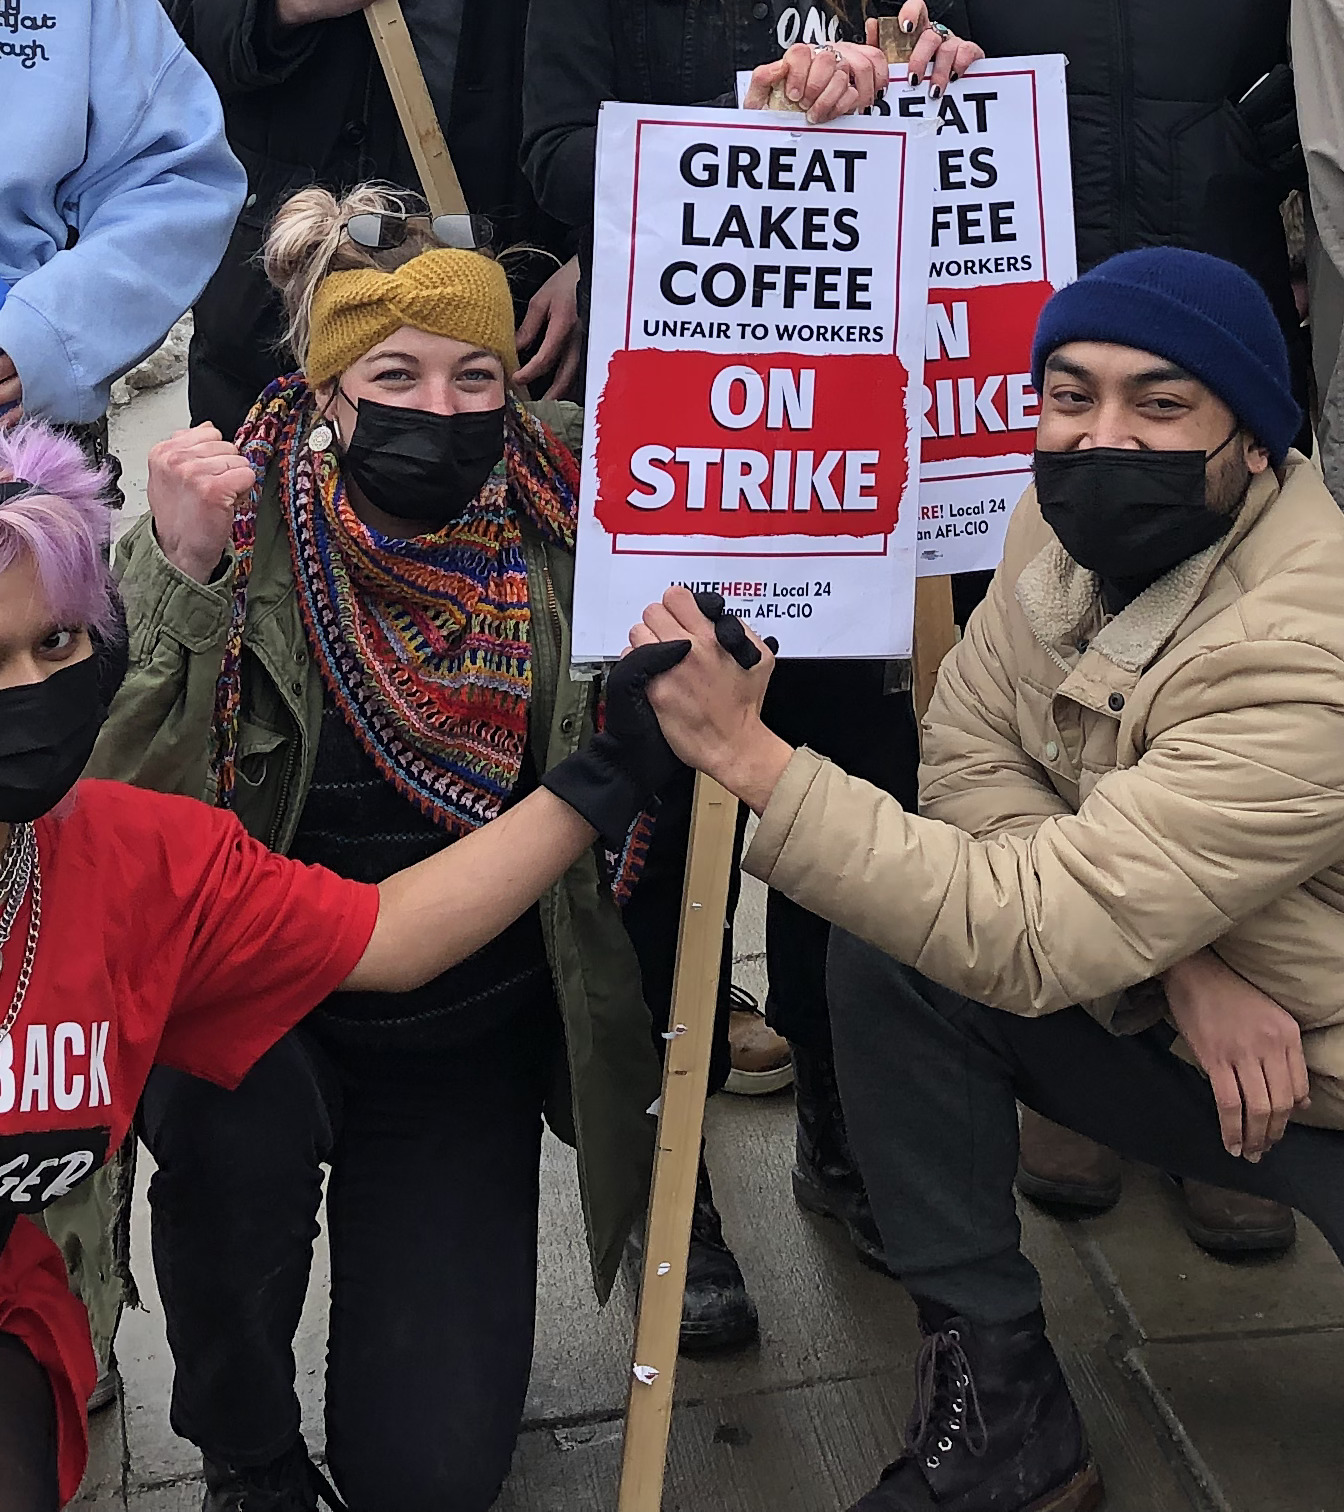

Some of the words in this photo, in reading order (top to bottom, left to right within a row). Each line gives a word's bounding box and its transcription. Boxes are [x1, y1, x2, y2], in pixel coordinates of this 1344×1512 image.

[874, 92, 997, 135] EAT
[680, 143, 867, 193] GREAT
[682, 203, 859, 252] LAKES
[931, 201, 1017, 247] FEE
[660, 261, 872, 310] COFFEE
[644, 320, 730, 339] UNFAIR
[737, 323, 768, 340] TO
[775, 324, 883, 342] WORKERS
[926, 302, 970, 360] N
[711, 366, 815, 428] ON
[627, 445, 879, 510] STRIKE
[935, 520, 988, 539] AFL-CIO
[950, 501, 984, 517] Local
[989, 499, 1005, 513] 24
[755, 603, 812, 618] AFL-CIO
[773, 582, 809, 597] Local
[814, 582, 831, 596] 24
